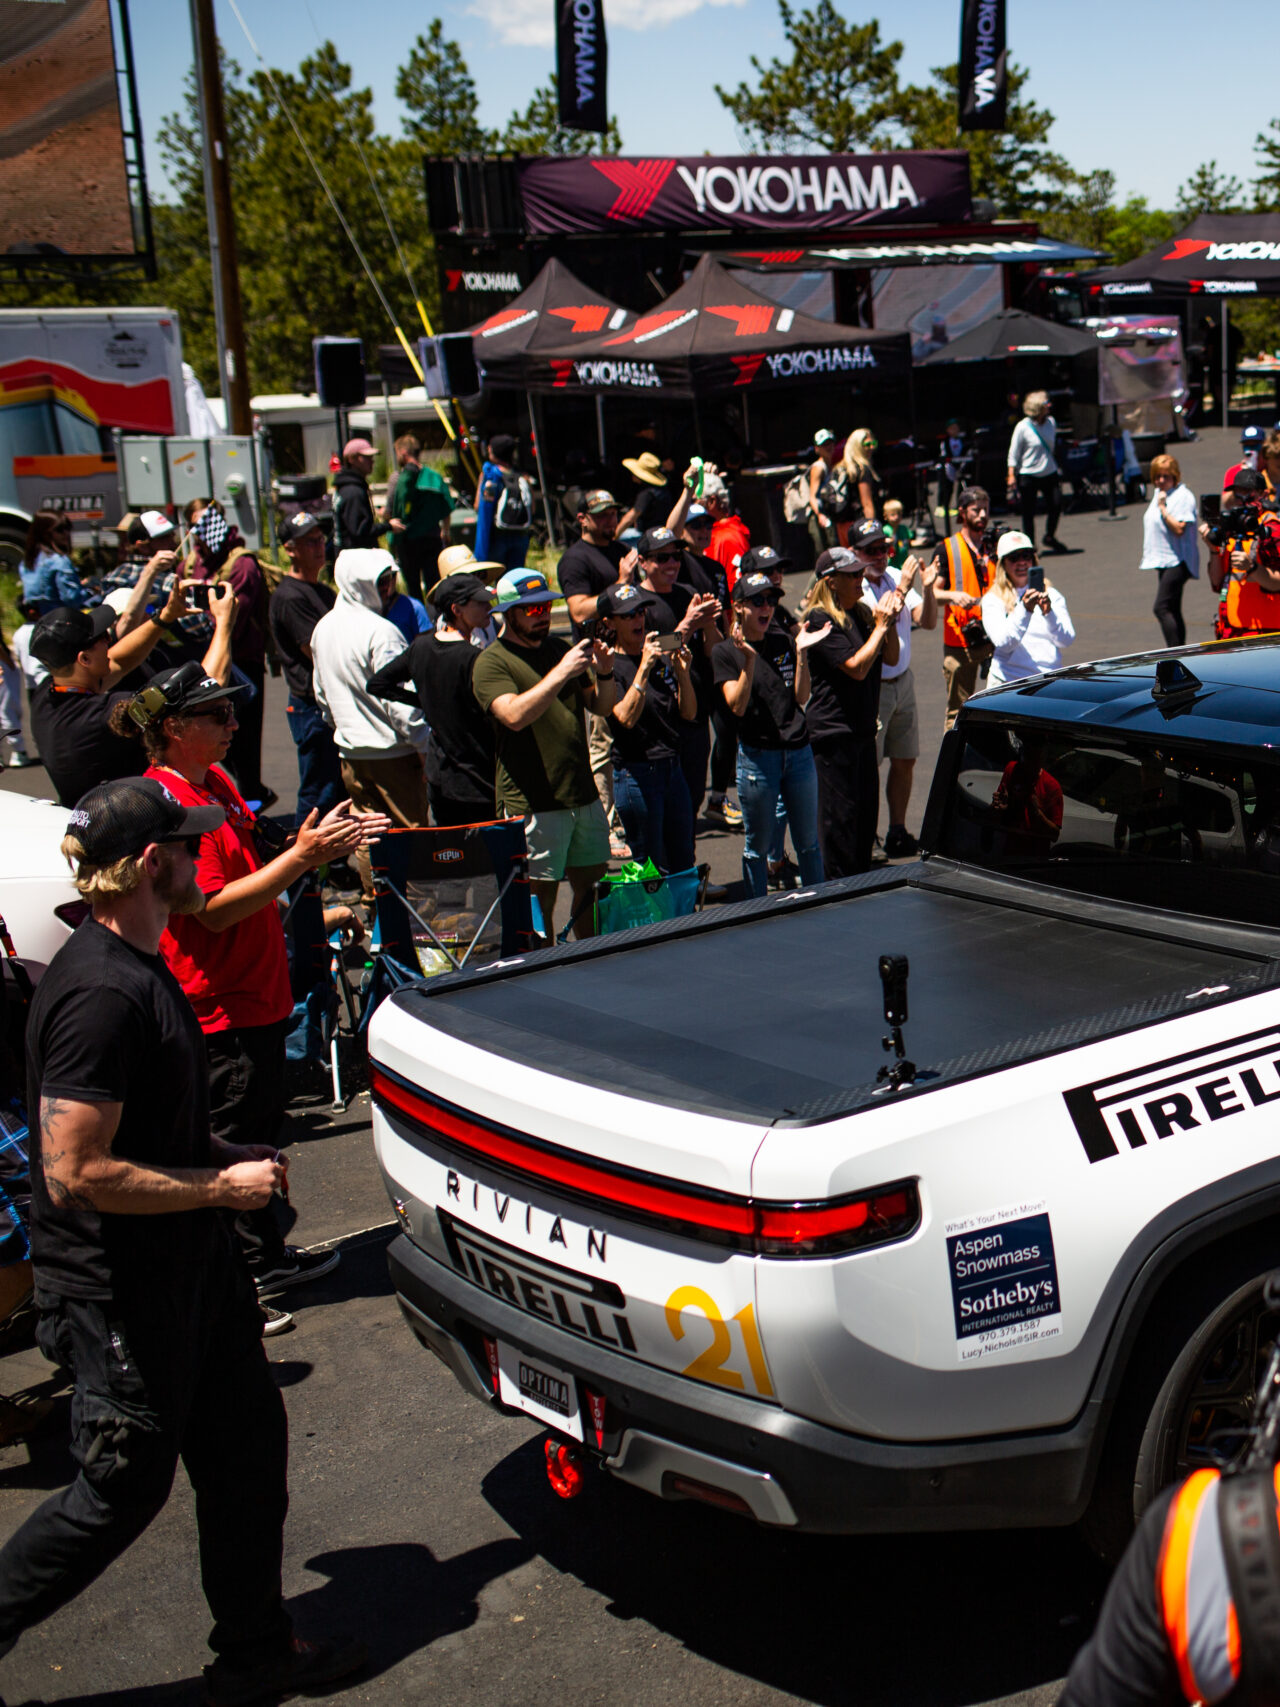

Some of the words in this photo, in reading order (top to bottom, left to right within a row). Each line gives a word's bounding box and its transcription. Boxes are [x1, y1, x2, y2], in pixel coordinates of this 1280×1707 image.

[676, 164, 920, 215] YOKOHAMA
[461, 271, 521, 292] YOKOHAMA
[765, 345, 879, 379] YOKOHAMA
[438, 850, 460, 861] TEPUI
[446, 1168, 608, 1264] RIVIAN
[945, 1218, 975, 1234] What's
[976, 1213, 996, 1226] Your
[998, 1208, 1018, 1221] Next
[1019, 1200, 1047, 1213] Move?
[954, 1233, 1003, 1258] Aspen
[955, 1245, 1041, 1278] Snowmass
[435, 1204, 639, 1354] PIRELLI
[960, 1280, 1053, 1318] Sotheby's
[962, 1311, 1025, 1333] INTERNATIONAL
[1026, 1301, 1055, 1316] REALTY
[978, 1319, 1042, 1343] 970.379.1587
[664, 1284, 775, 1398] 21
[519, 1364, 569, 1406] OPTIMA
